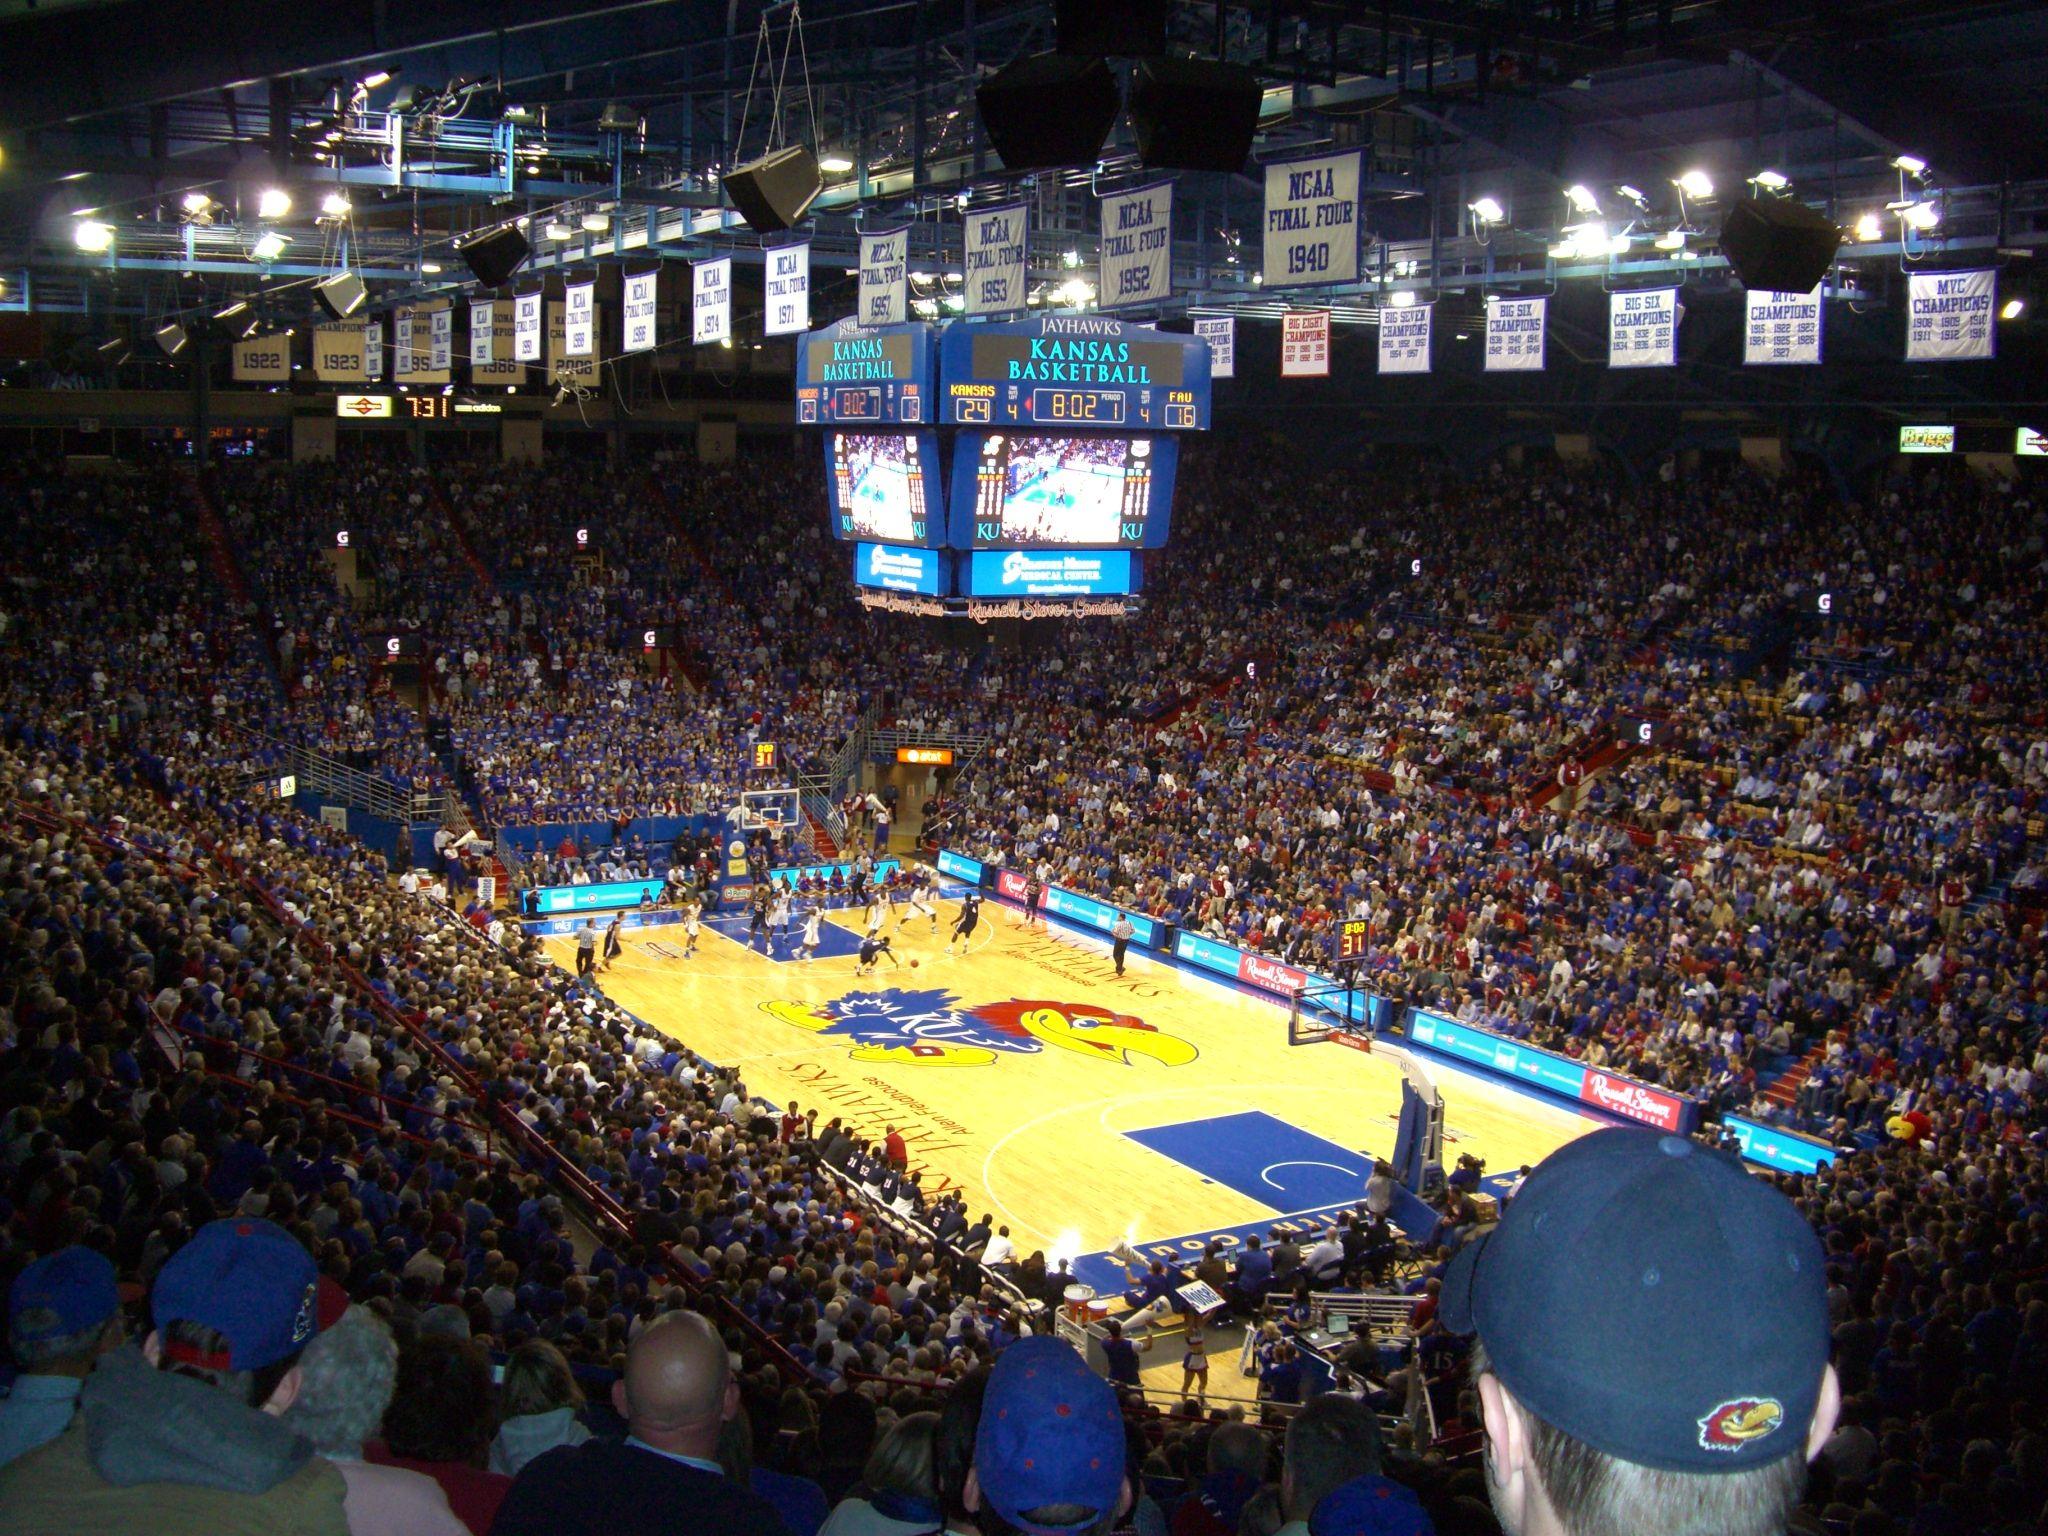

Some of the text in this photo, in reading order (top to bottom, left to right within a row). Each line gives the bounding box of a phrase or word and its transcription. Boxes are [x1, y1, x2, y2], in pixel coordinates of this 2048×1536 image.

[1288, 168, 1334, 200] NCAA
[1118, 200, 1152, 230] NCAA
[1269, 200, 1352, 231] FINAL FOUR
[980, 219, 1010, 245] NCAA
[1105, 227, 1167, 257] FINAL FOUR
[870, 241, 895, 263] NCAA
[966, 245, 1023, 269] FINAL FOUR
[1288, 242, 1329, 273] 1940
[777, 253, 797, 275] NCAA
[703, 267, 720, 288] NCAA
[861, 264, 903, 285] FINAL FOUR
[1119, 266, 1150, 294] 1952
[768, 276, 806, 296] FINAL FOUR
[981, 278, 1007, 303] 1953
[1937, 279, 1966, 294] MVC
[696, 288, 727, 307] FINAL FOUR
[1625, 296, 1660, 310] BIG SIX
[1913, 295, 1989, 314] CHAMPIONS
[779, 304, 794, 324] 1971
[1385, 310, 1425, 323] BIG SEVEN
[1500, 304, 1532, 317] BIG SIX
[1614, 311, 1671, 326] CHAMPIONS
[1751, 305, 1816, 320] CHAMPIONS
[704, 314, 719, 334] 1974
[1041, 318, 1122, 336] JAYHAWKS
[1289, 316, 1324, 329] BIG EIGHT
[1382, 324, 1427, 337] CHAMPIONS
[1489, 319, 1540, 332] CHAMPIONS
[1286, 330, 1326, 342] CHAMPIONS
[1913, 331, 1931, 340] 1911
[834, 339, 883, 360] KANSAS
[1030, 339, 1129, 363] KANSAS
[242, 353, 280, 369] 1922
[324, 354, 360, 370] 1923
[823, 361, 894, 381] BASKETBALL
[1008, 361, 1151, 384] BASKETBALL
[950, 385, 995, 397] KANSAS
[1101, 392, 1121, 401] PERIOD
[1169, 391, 1192, 403] FAU
[406, 397, 446, 417] 7:31
[964, 401, 988, 420] 24
[1008, 404, 1017, 419] 4
[1053, 394, 1096, 418] 8:02
[1140, 408, 1149, 423] 4
[1178, 407, 1193, 426] 16
[1903, 429, 1954, 447] Briggs
[337, 532, 349, 546] G
[577, 530, 587, 544] G
[913, 522, 926, 539] KU
[977, 523, 1000, 541] KU
[1121, 523, 1143, 541] KU
[1411, 560, 1420, 573] G
[1818, 594, 1830, 609] G
[968, 600, 1020, 624] Russell
[1022, 600, 1069, 620] Stover
[388, 639, 399, 652] G
[644, 631, 655, 645] G
[1247, 663, 1255, 676] G
[1639, 724, 1651, 739] G
[756, 752, 773, 766] 31
[1344, 921, 1365, 935] 8:02
[1342, 935, 1362, 956] 31
[1246, 957, 1276, 980] Russell
[887, 1011, 979, 1038] KU
[862, 1076, 975, 1135] Allen Fieldhouse
[1590, 1074, 1672, 1119] Russell Stover
[778, 1063, 971, 1153] JAYHAWKS
[1612, 1103, 1664, 1127] CANDIES
[860, 1164, 870, 1177] 52
[933, 1216, 941, 1228] 5
[1104, 1233, 1240, 1267] Cout
